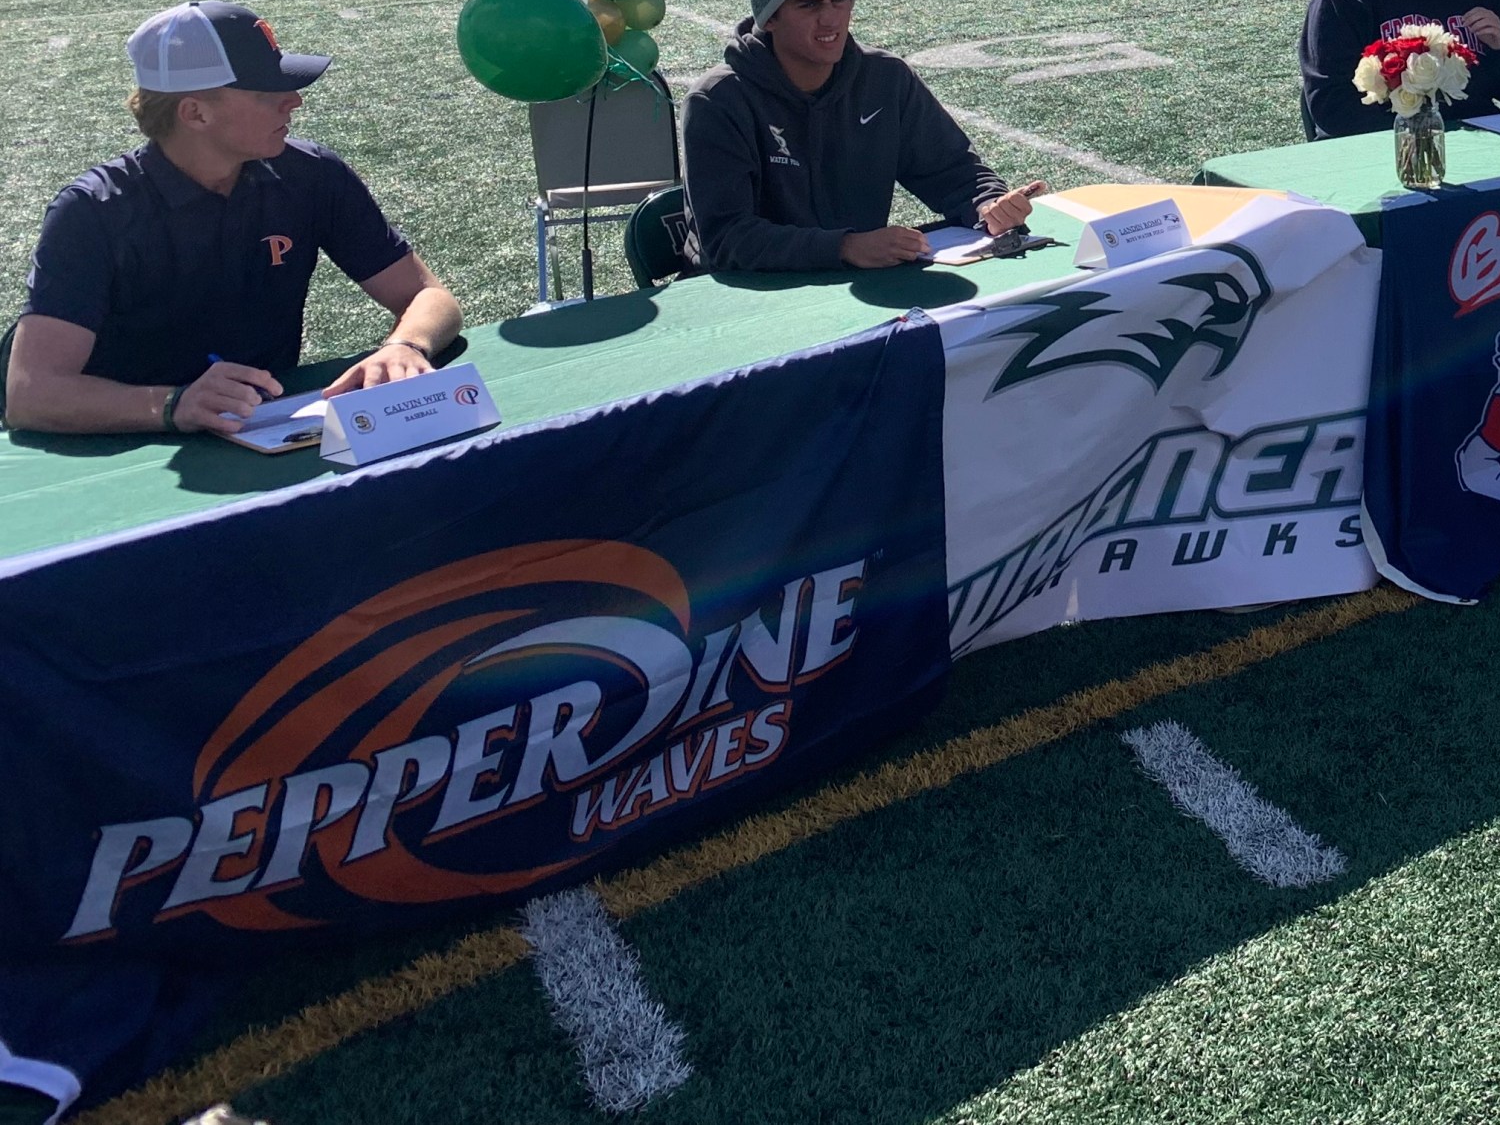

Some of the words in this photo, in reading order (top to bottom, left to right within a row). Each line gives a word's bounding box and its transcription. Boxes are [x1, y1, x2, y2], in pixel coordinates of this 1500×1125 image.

[260, 235, 292, 265] P
[384, 398, 422, 416] CALVIN
[404, 408, 439, 422] BASEBALL
[62, 559, 868, 943] PEPPERDINE
[570, 701, 792, 842] WAVES
